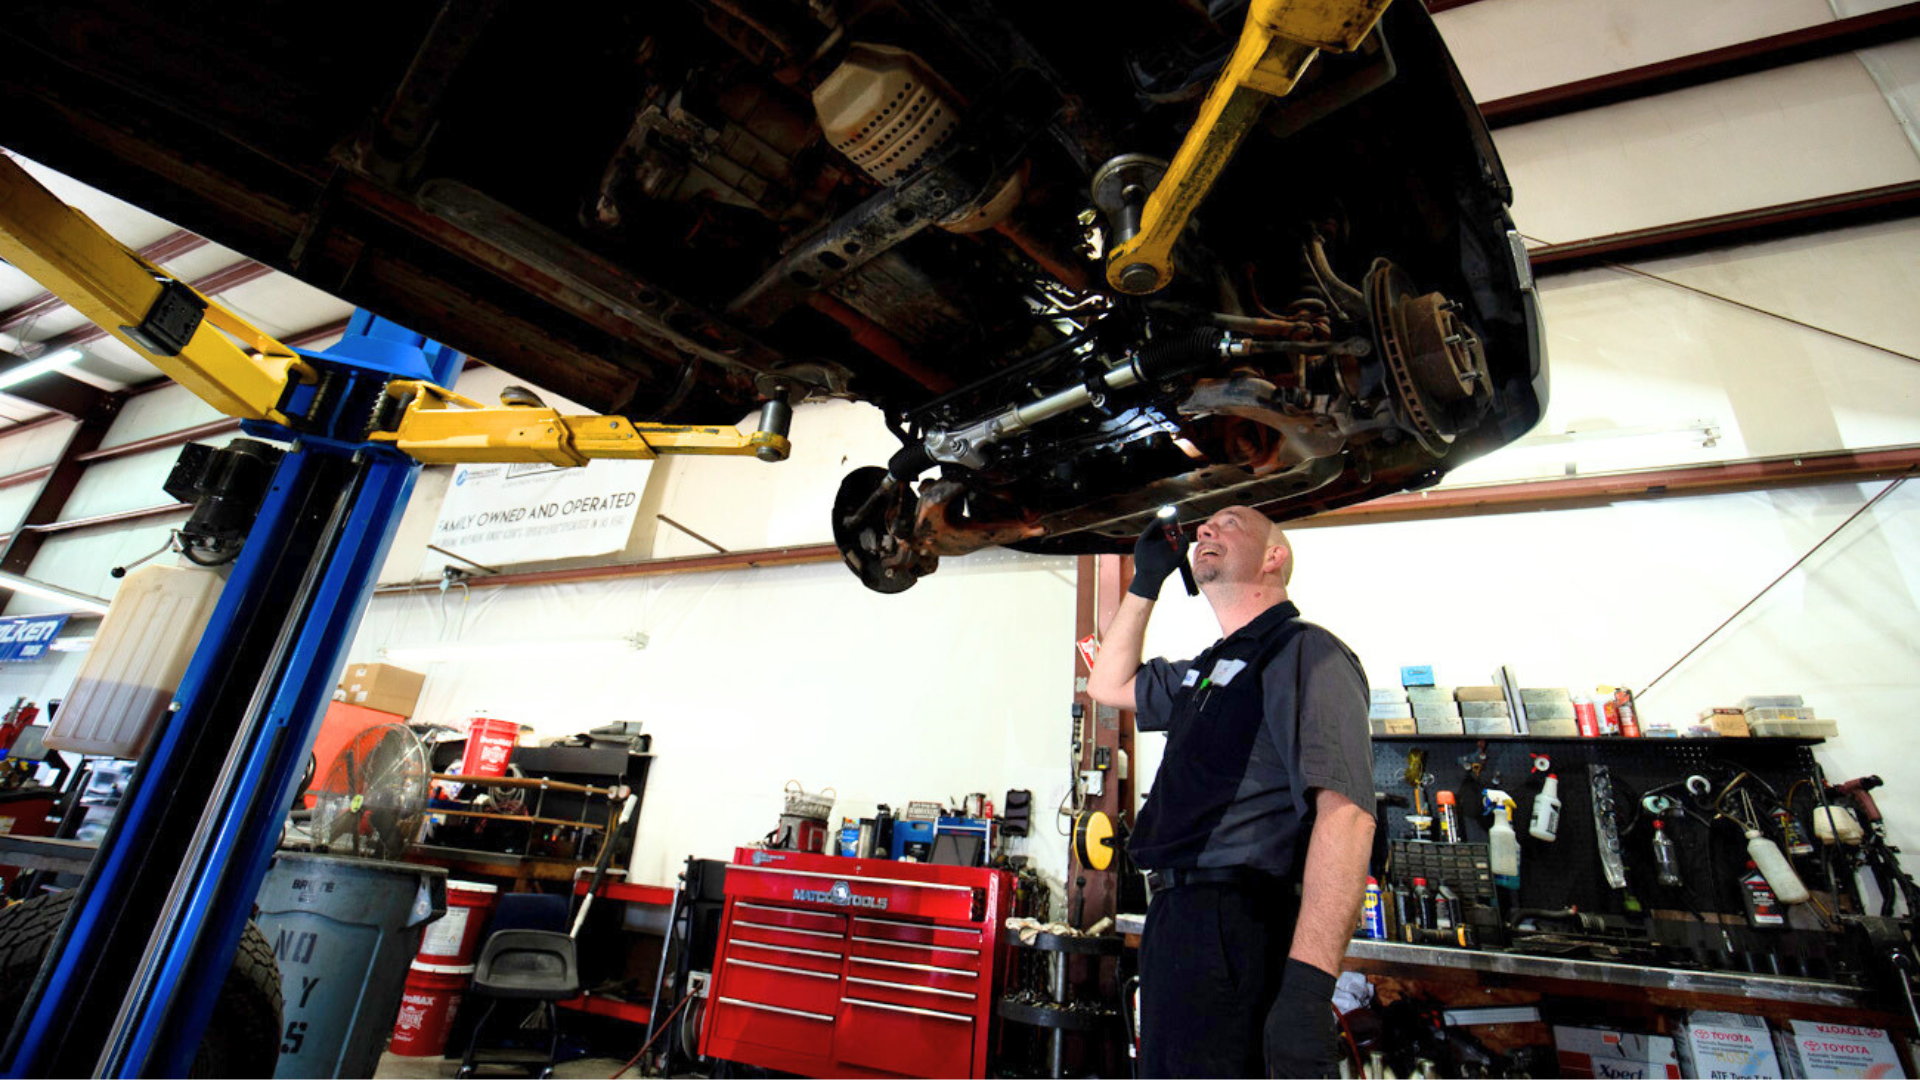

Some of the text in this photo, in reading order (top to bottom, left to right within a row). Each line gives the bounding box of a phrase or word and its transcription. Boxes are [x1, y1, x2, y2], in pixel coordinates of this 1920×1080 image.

[438, 492, 636, 532] FAMILY OWNED AND OPERATED
[793, 888, 888, 910] MATCO TOOLS
[1816, 1025, 1864, 1036] TOYOTA
[1710, 1031, 1752, 1043] TOYOTA
[1822, 1043, 1871, 1055] TOYOTA
